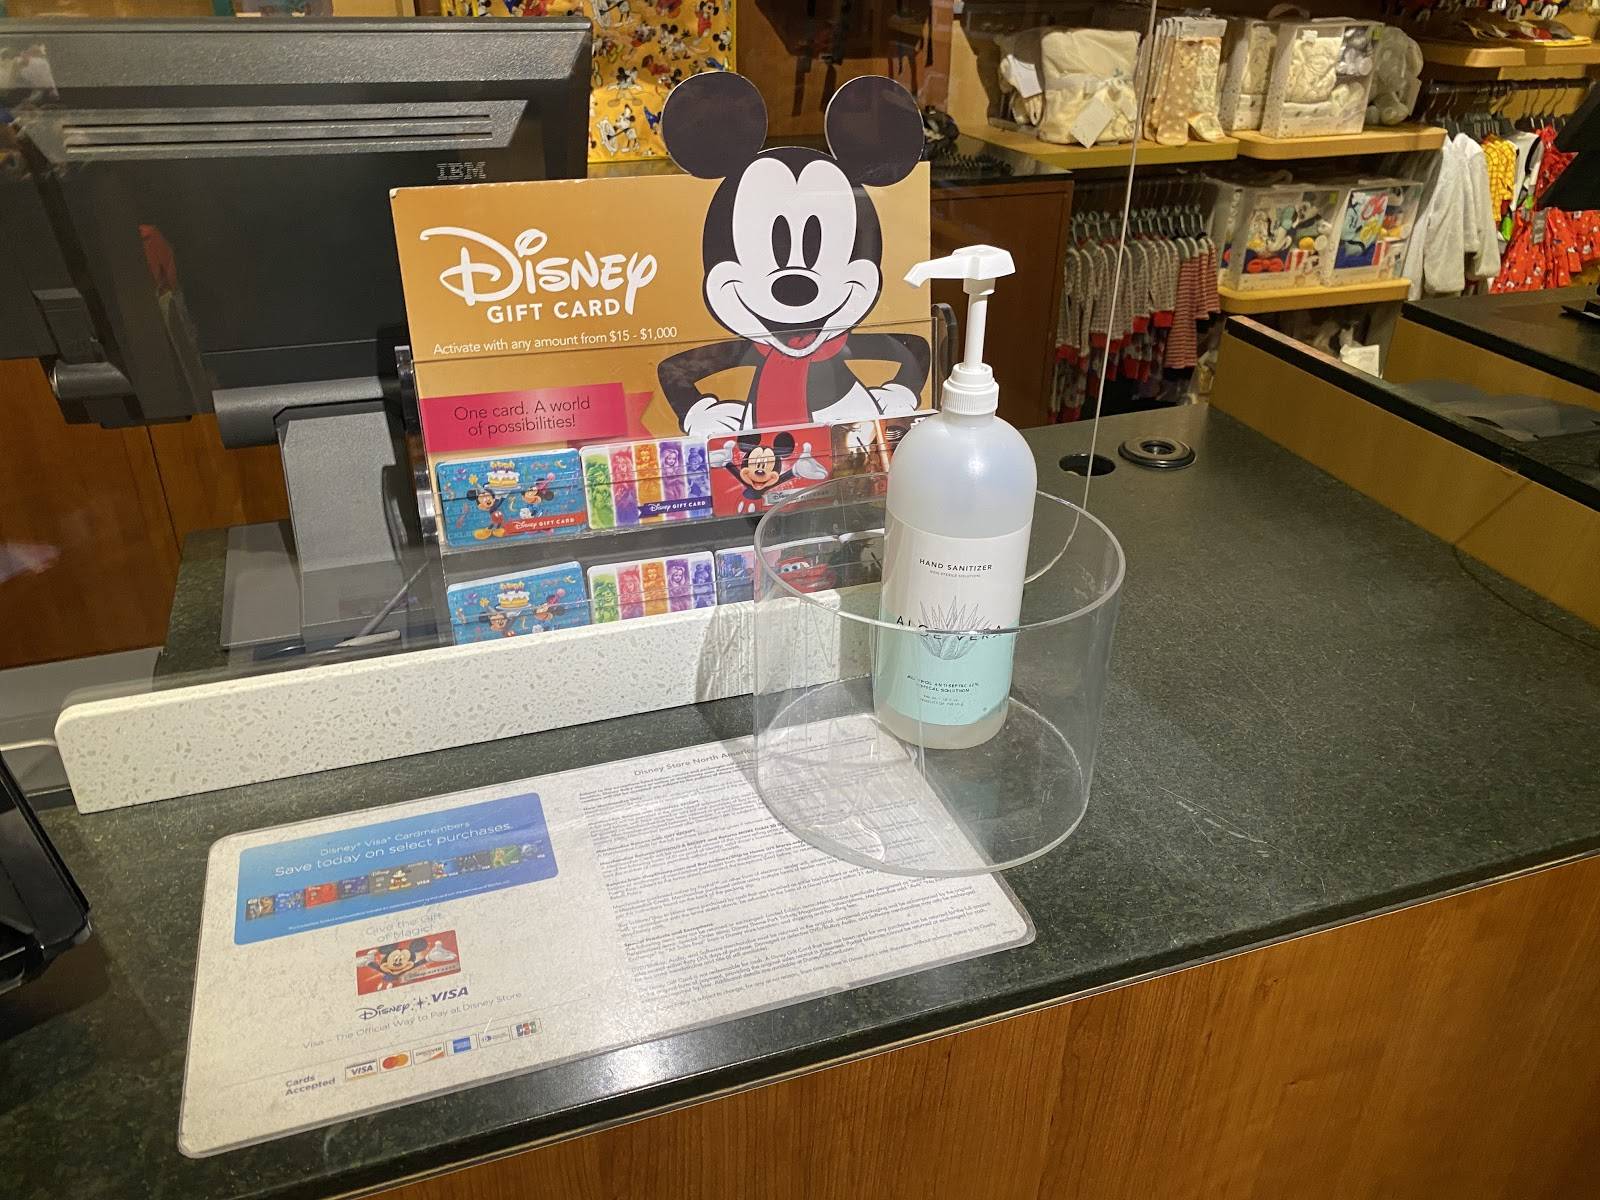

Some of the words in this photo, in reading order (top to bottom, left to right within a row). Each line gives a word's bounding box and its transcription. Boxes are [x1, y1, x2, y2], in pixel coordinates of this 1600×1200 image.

[437, 162, 486, 181] IBM
[419, 226, 658, 315] Disney
[487, 302, 543, 324] GIFT
[553, 298, 620, 319] CARD
[433, 342, 481, 356] Activate
[483, 339, 509, 352] with
[511, 338, 531, 351] any
[534, 334, 578, 348] amount
[580, 332, 607, 345] from
[608, 329, 630, 343] $15
[640, 326, 677, 342] $1,000
[454, 405, 489, 421] One
[492, 401, 528, 418] card.
[534, 399, 546, 413] A
[550, 397, 591, 412] world
[467, 422, 483, 437] of
[488, 413, 576, 438] possibilities!
[648, 501, 671, 512] Disney
[512, 520, 537, 530] Disney
[538, 519, 554, 527] GIFT
[555, 517, 575, 525] CARD
[919, 558, 944, 569] HAND
[947, 564, 992, 572] SANITIZER
[634, 766, 664, 776] Disney
[666, 760, 690, 770] Store
[692, 755, 719, 765] North
[275, 863, 312, 877] Save
[317, 854, 361, 870] today
[365, 848, 385, 859] on
[389, 839, 433, 855] select
[437, 823, 514, 845] purchases.
[355, 1003, 410, 1020] Disney
[432, 986, 469, 1002] VISA
[355, 1022, 391, 1037] Official
[393, 1017, 415, 1028] Way
[417, 1013, 429, 1023] to
[430, 1009, 448, 1021] Pay
[450, 1006, 461, 1015] at
[463, 1000, 494, 1013] Disney
[496, 992, 522, 1004] Store
[286, 1075, 315, 1088] Cards
[351, 1065, 374, 1076] VISA
[285, 1077, 336, 1096] Accepted
